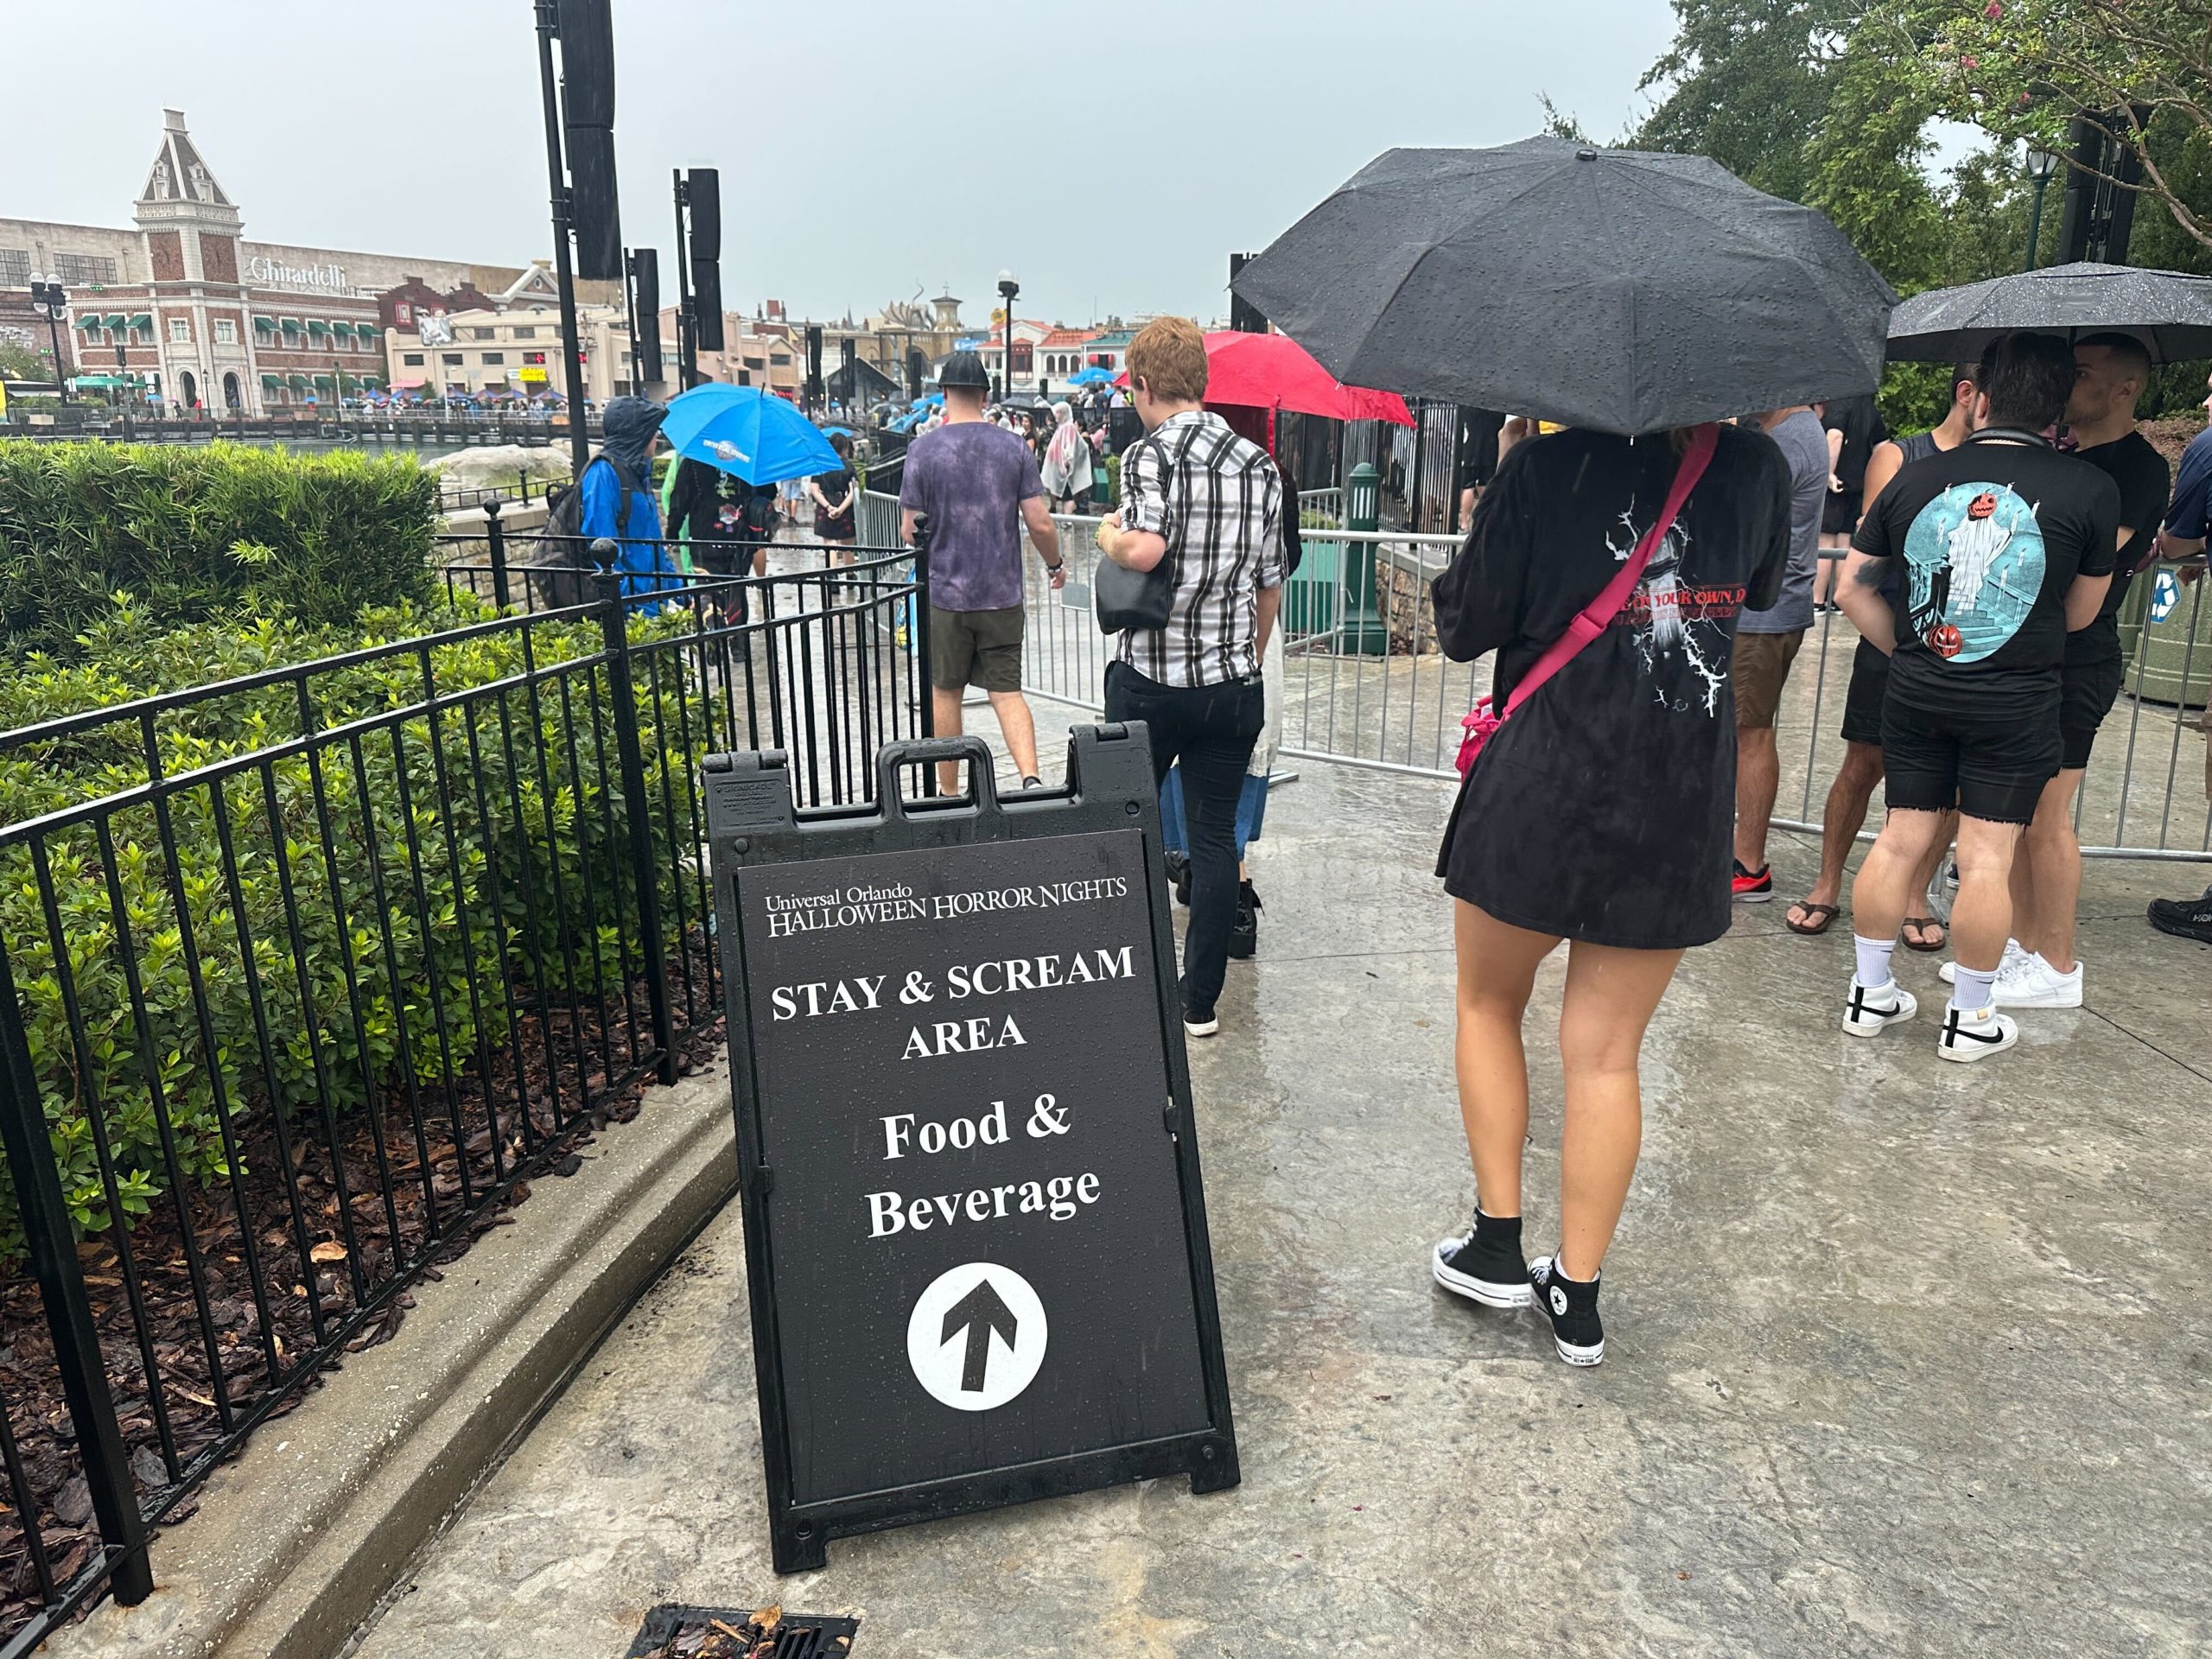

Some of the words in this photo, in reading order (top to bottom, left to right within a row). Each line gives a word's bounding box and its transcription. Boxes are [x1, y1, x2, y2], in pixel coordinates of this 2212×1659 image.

[251, 257, 346, 287] Ghirardelli
[1656, 589, 1692, 607] YOUR
[765, 888, 842, 912] Universal
[846, 881, 912, 903] Orlando
[766, 897, 927, 938] HALLOWEEN
[931, 887, 1039, 920] HORROR
[1038, 876, 1128, 908] NIGHTS
[772, 975, 887, 1022] STAY
[899, 970, 935, 1005] &
[947, 945, 1136, 1000] SCREAM
[900, 1014, 1028, 1060] AREA
[879, 1100, 1011, 1160] Food
[1026, 1093, 1071, 1138] &
[863, 1173, 1102, 1238] Beverage
